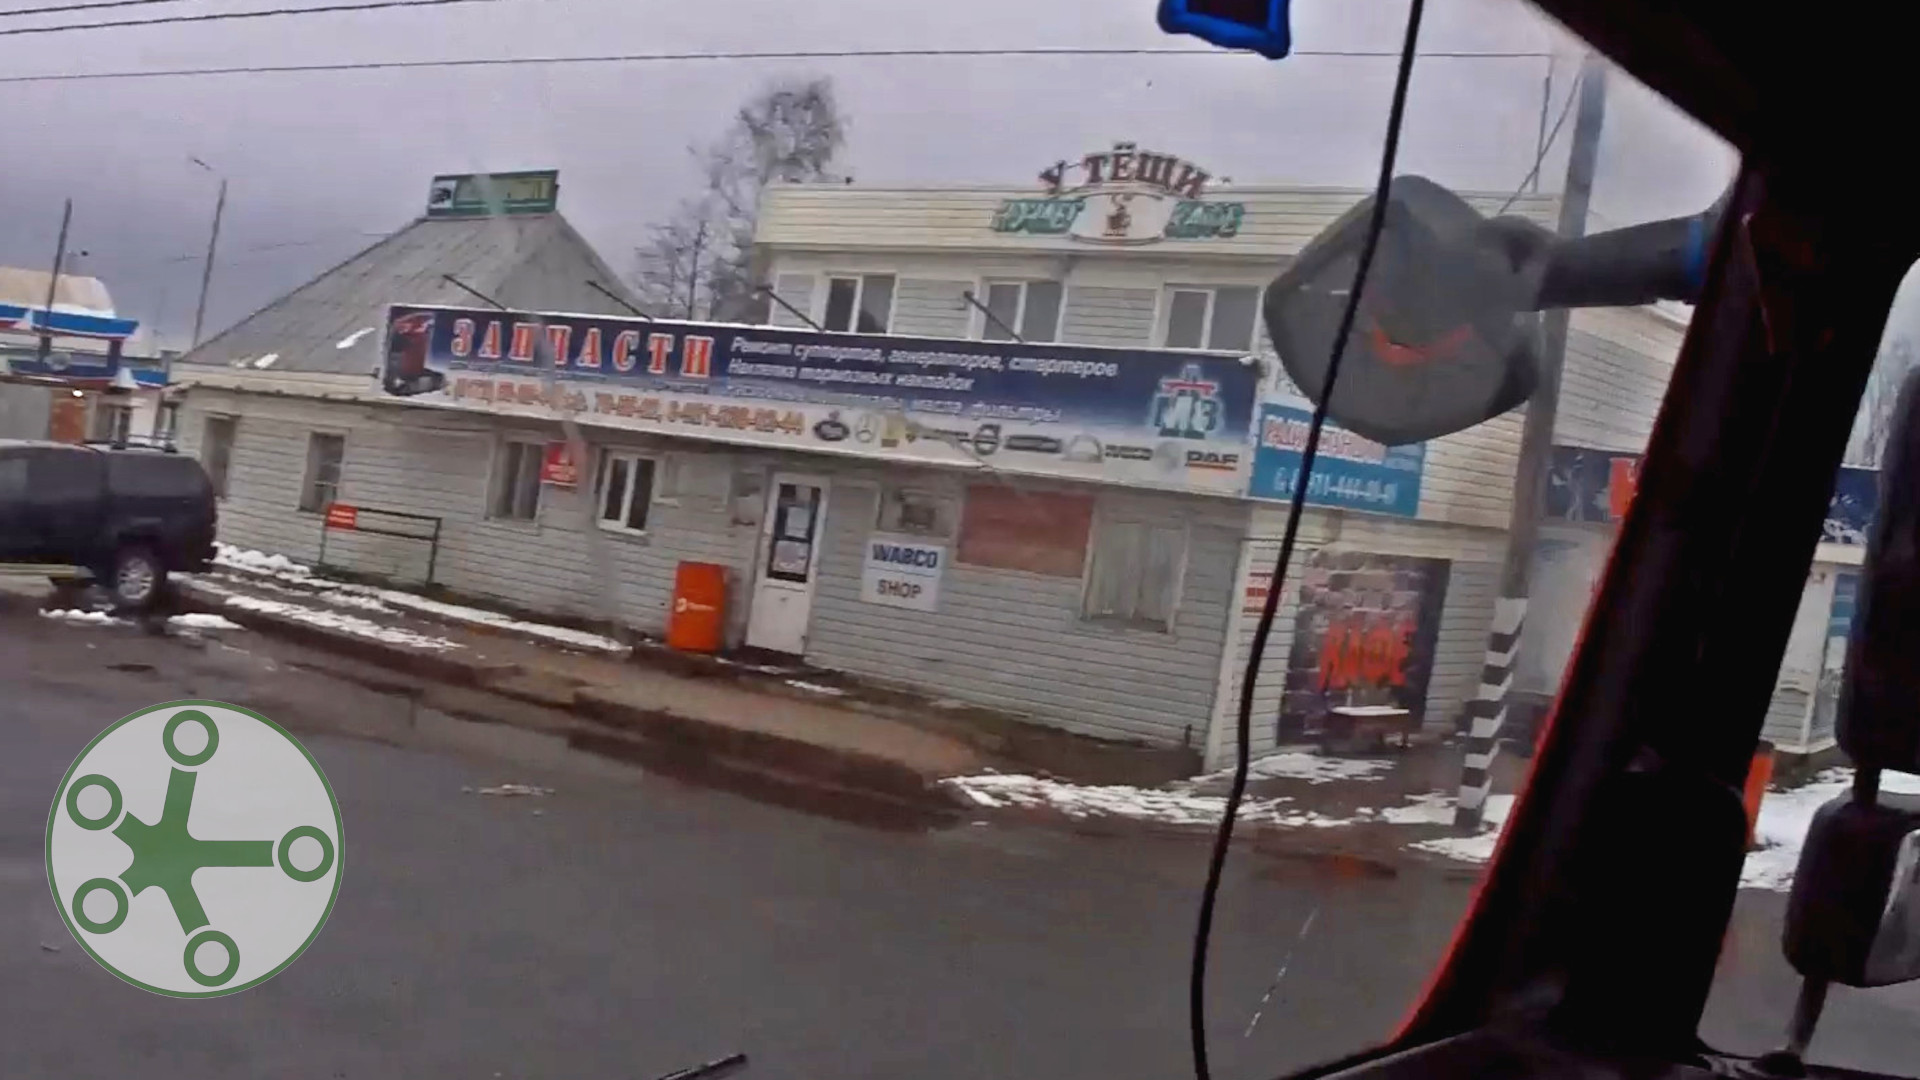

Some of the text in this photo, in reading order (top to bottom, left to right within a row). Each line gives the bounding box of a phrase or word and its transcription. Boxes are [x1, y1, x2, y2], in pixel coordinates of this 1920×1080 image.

[450, 317, 716, 378] ЗАПЧАСТИ
[872, 544, 938, 570] WABCO
[876, 578, 922, 599] SHOP
